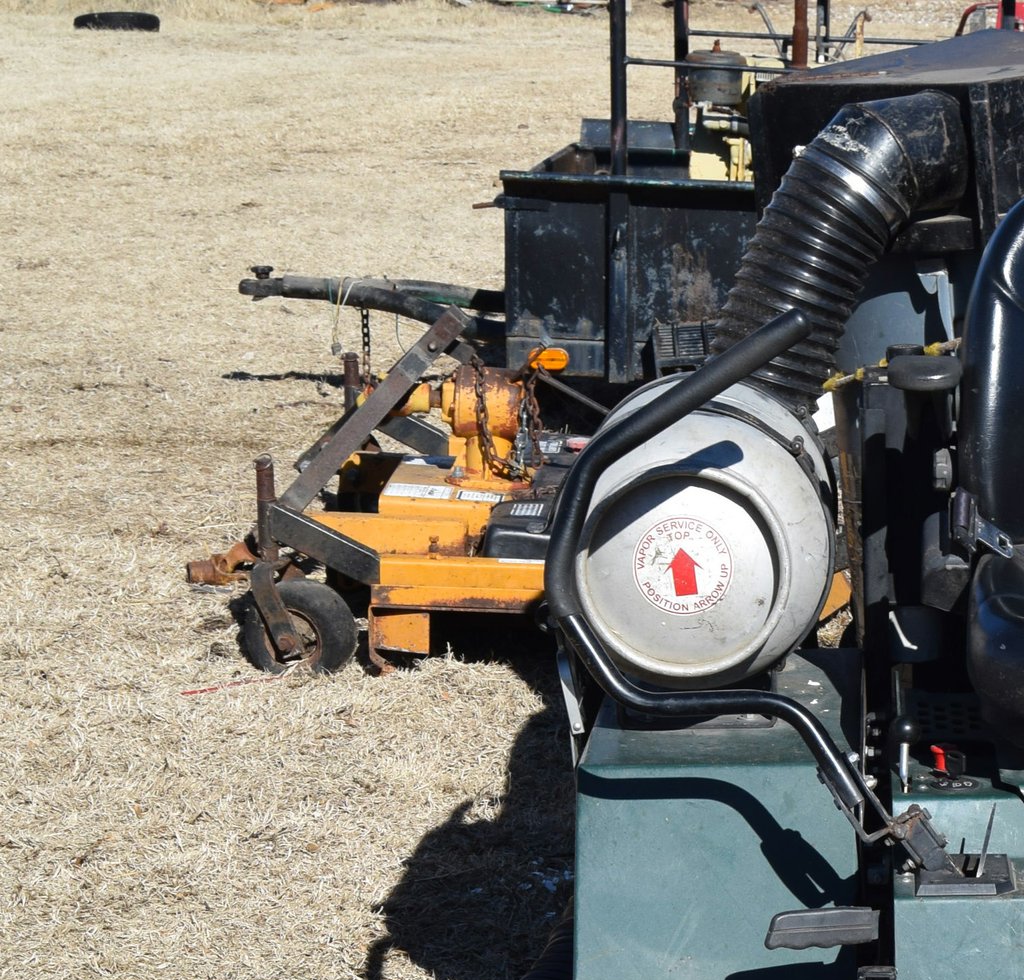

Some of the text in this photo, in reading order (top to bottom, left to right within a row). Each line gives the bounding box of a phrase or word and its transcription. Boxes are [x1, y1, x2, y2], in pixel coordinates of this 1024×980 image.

[637, 521, 727, 569] VAPOR SERVICE ONLY
[666, 531, 690, 541] TOP
[643, 563, 729, 611] POSITION ARROW UP
